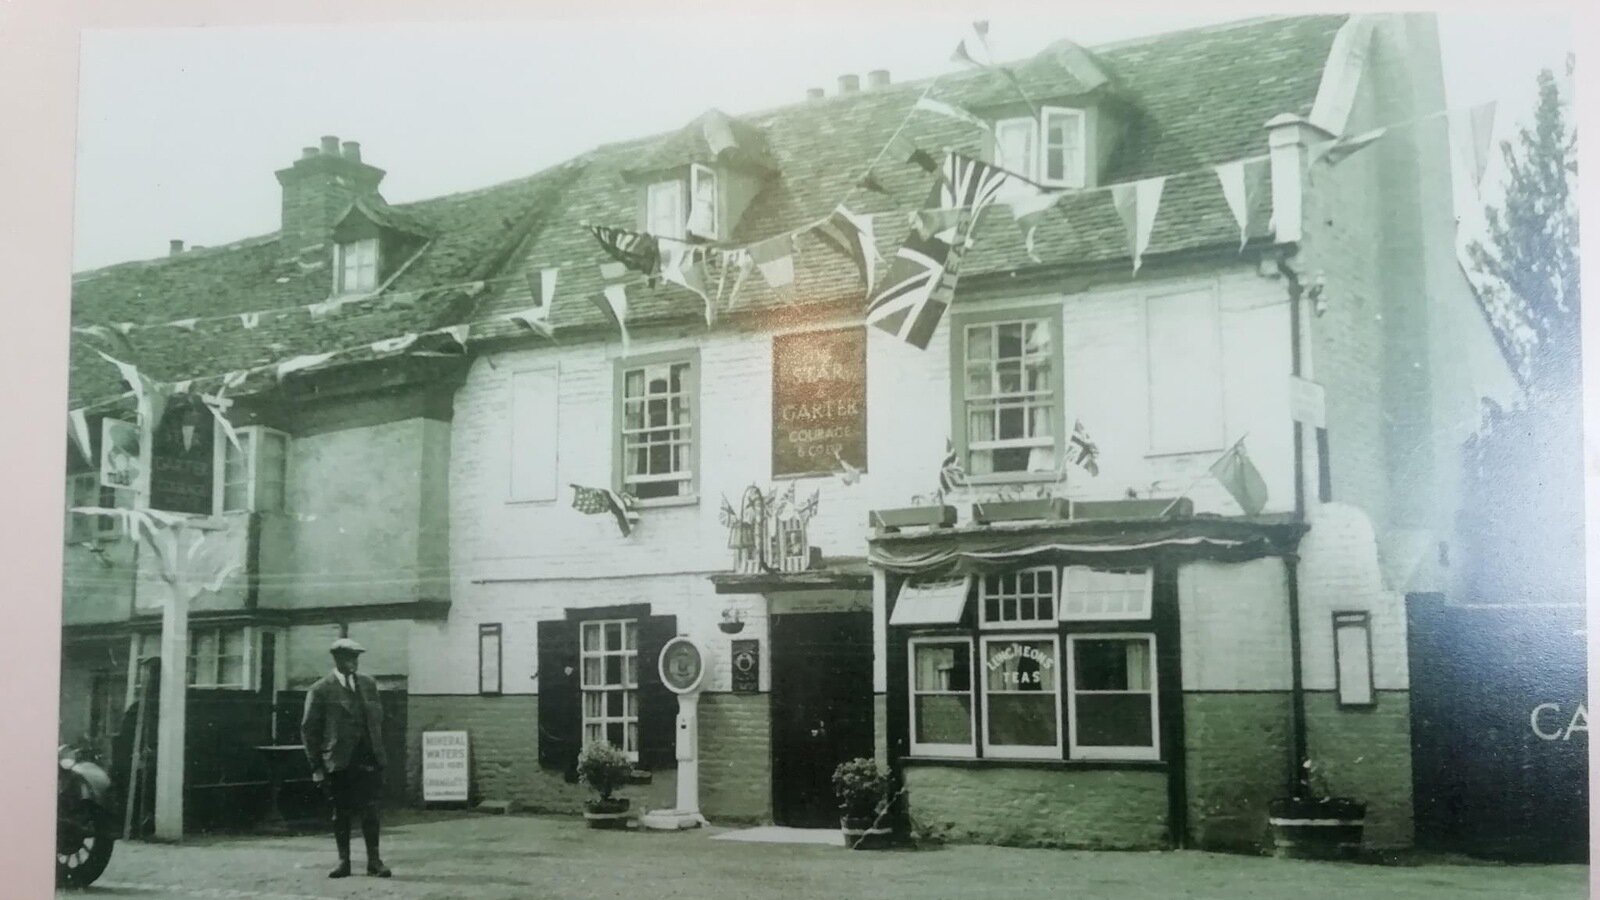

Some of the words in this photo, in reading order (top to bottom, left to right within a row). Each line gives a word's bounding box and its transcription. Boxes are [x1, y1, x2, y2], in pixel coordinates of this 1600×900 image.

[782, 399, 858, 421] GARTER
[788, 426, 851, 443] COURAGE
[987, 643, 1054, 671] LUNCHEONS
[1003, 670, 1041, 683] TEAS
[426, 735, 466, 747] MINERAL
[426, 748, 466, 759] WATERS
